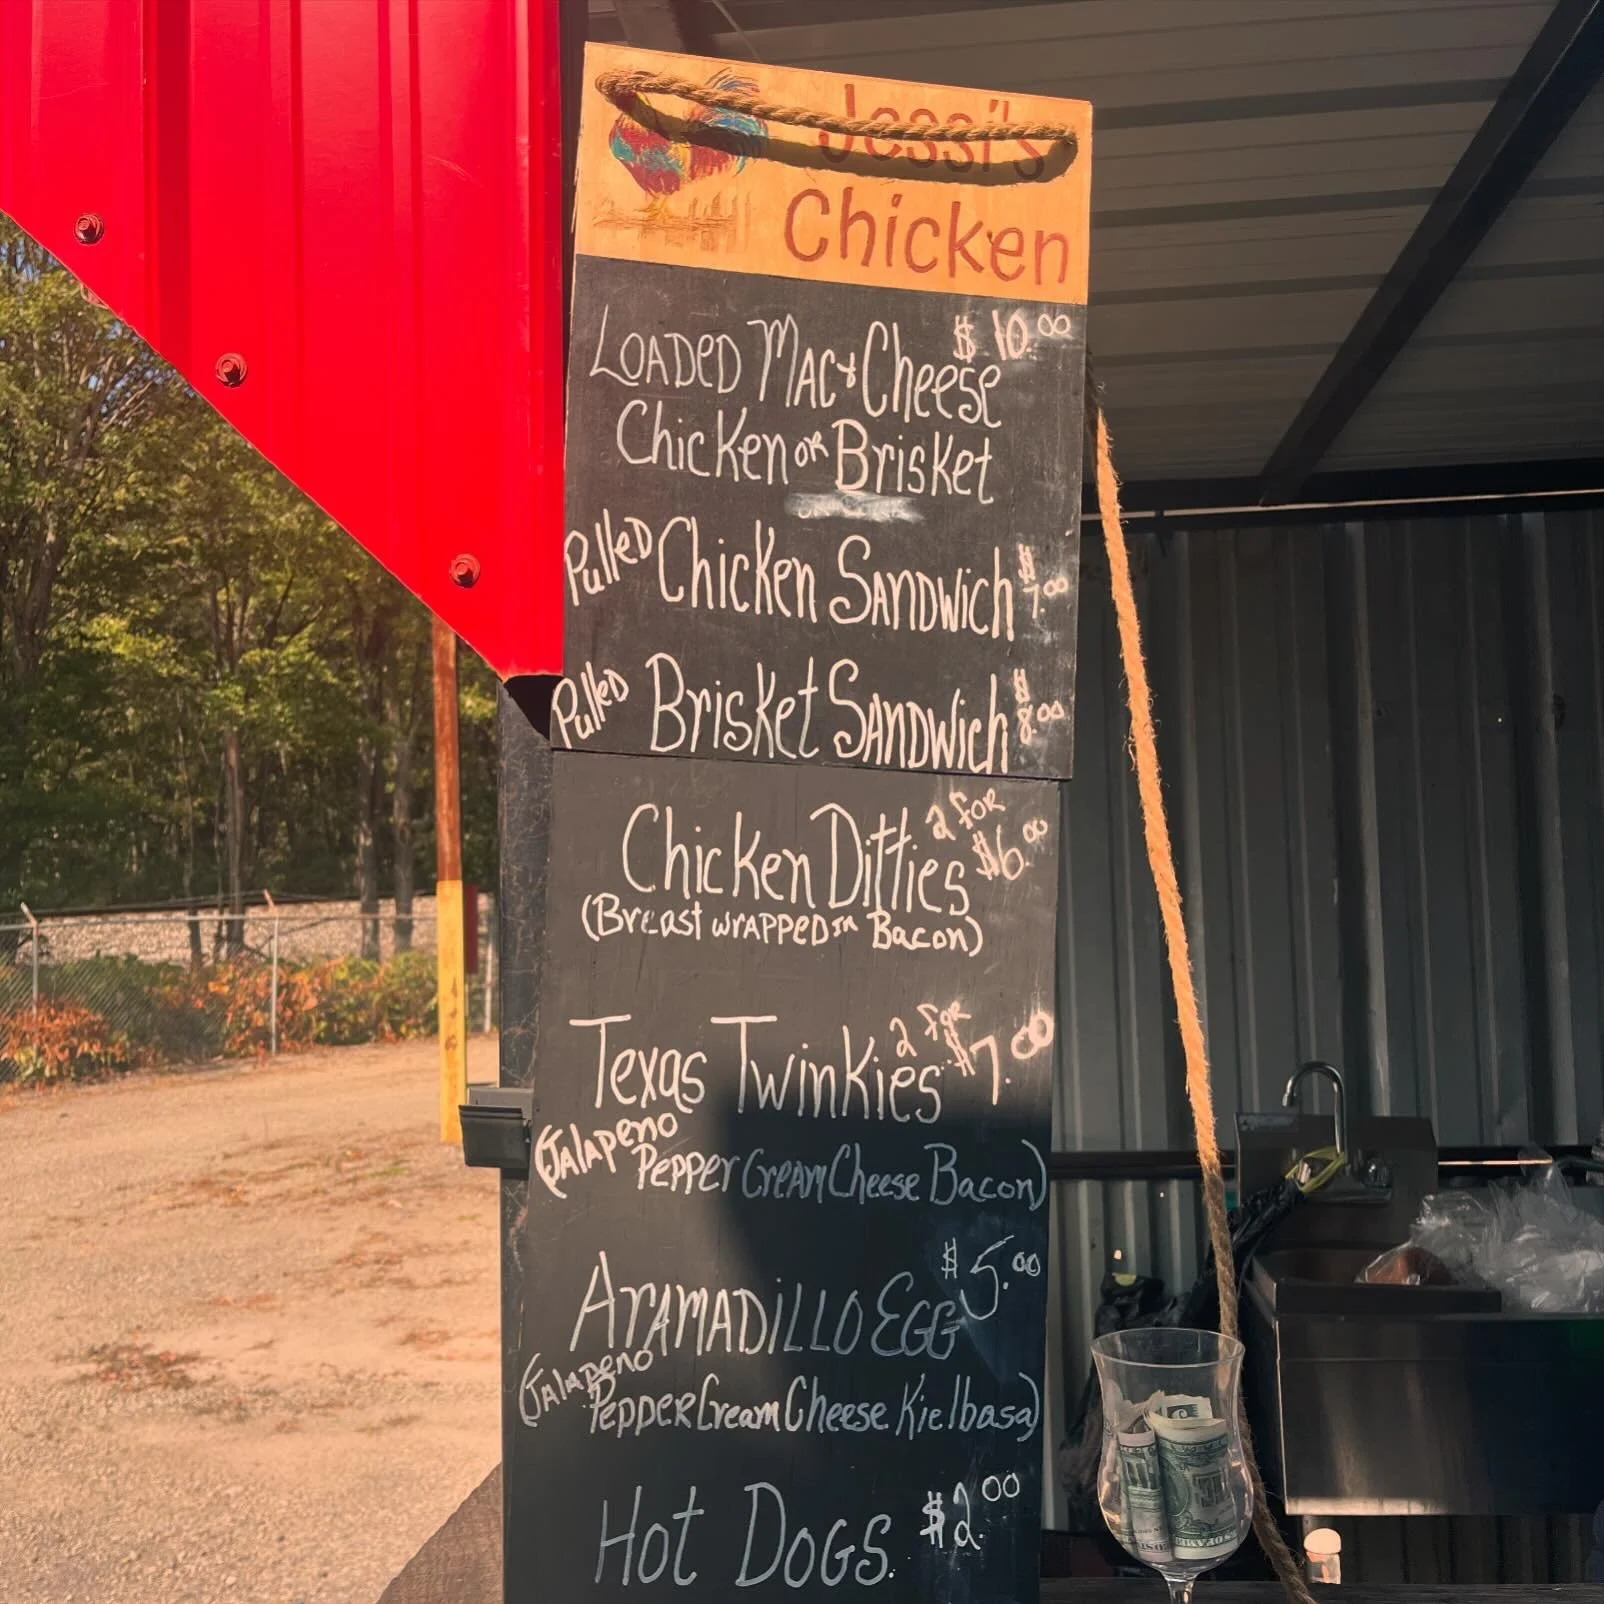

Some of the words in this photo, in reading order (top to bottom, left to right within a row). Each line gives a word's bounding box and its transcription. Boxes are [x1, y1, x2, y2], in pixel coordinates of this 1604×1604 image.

[784, 186, 1069, 286] Chicken
[862, 320, 1002, 428] Cheese
[866, 909, 984, 957] Bacon)
[889, 1016, 918, 1058] 2
[923, 1138, 1047, 1212] Bacon)
